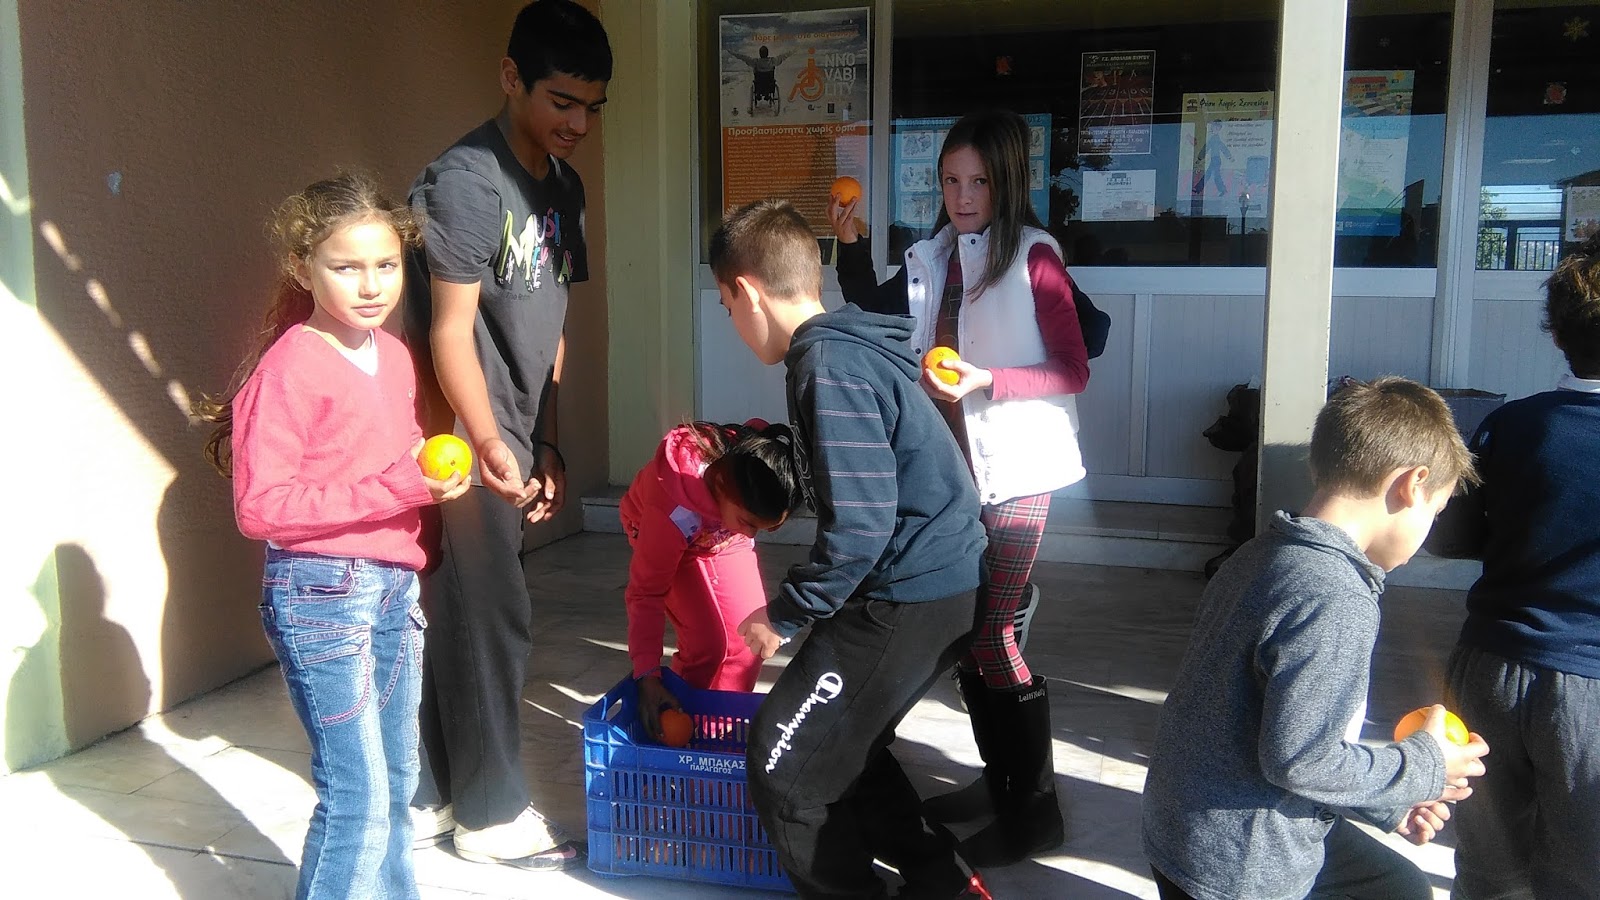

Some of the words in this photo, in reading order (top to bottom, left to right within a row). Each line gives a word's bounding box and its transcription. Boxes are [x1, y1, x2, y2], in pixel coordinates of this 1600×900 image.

[728, 126, 804, 136] Προσβασιμότητα
[806, 125, 833, 135] χωρίς
[835, 124, 856, 134] όρια
[765, 672, 843, 775] Champion
[678, 755, 696, 765] ΧΡ.
[699, 757, 746, 770] ΜΠΑΚΑΣ
[690, 764, 733, 775] ΠΑΡΑΓΩΓΟΣ
